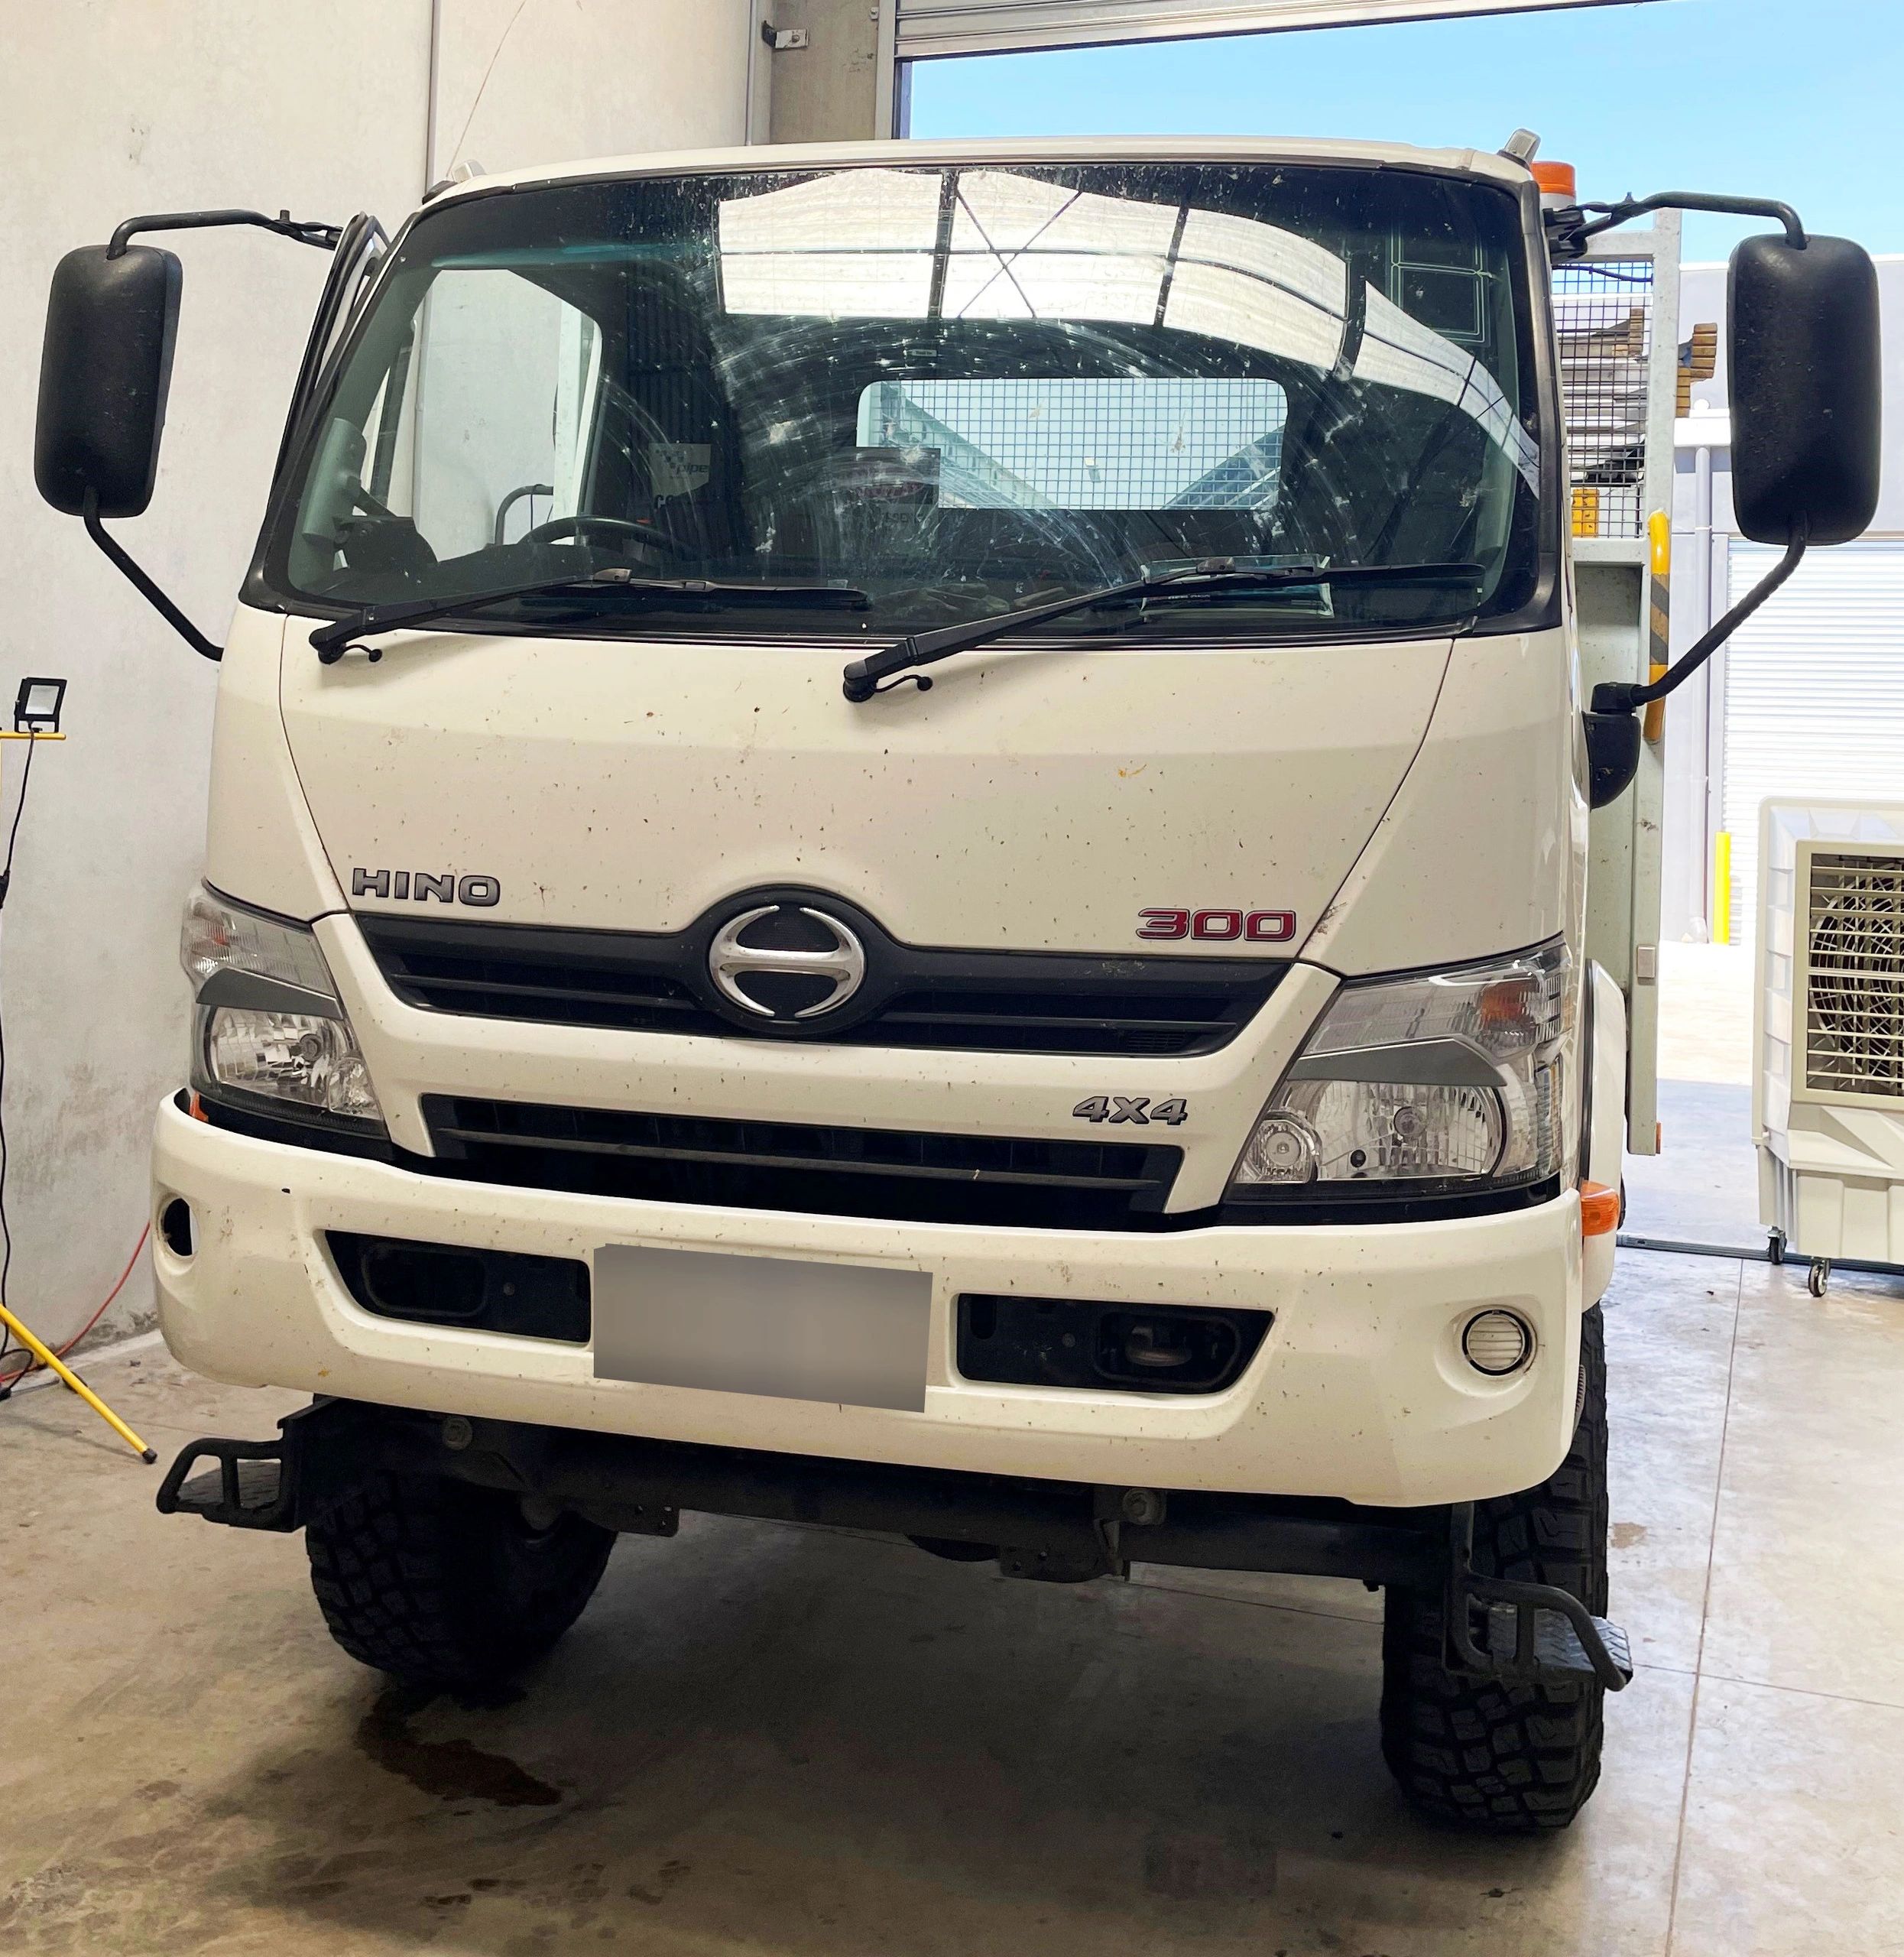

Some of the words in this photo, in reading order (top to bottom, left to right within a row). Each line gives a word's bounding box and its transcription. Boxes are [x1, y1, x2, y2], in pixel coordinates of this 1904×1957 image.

[352, 868, 501, 907] HINO
[1135, 907, 1296, 943] 300
[1072, 1095, 1189, 1126] 4X4
